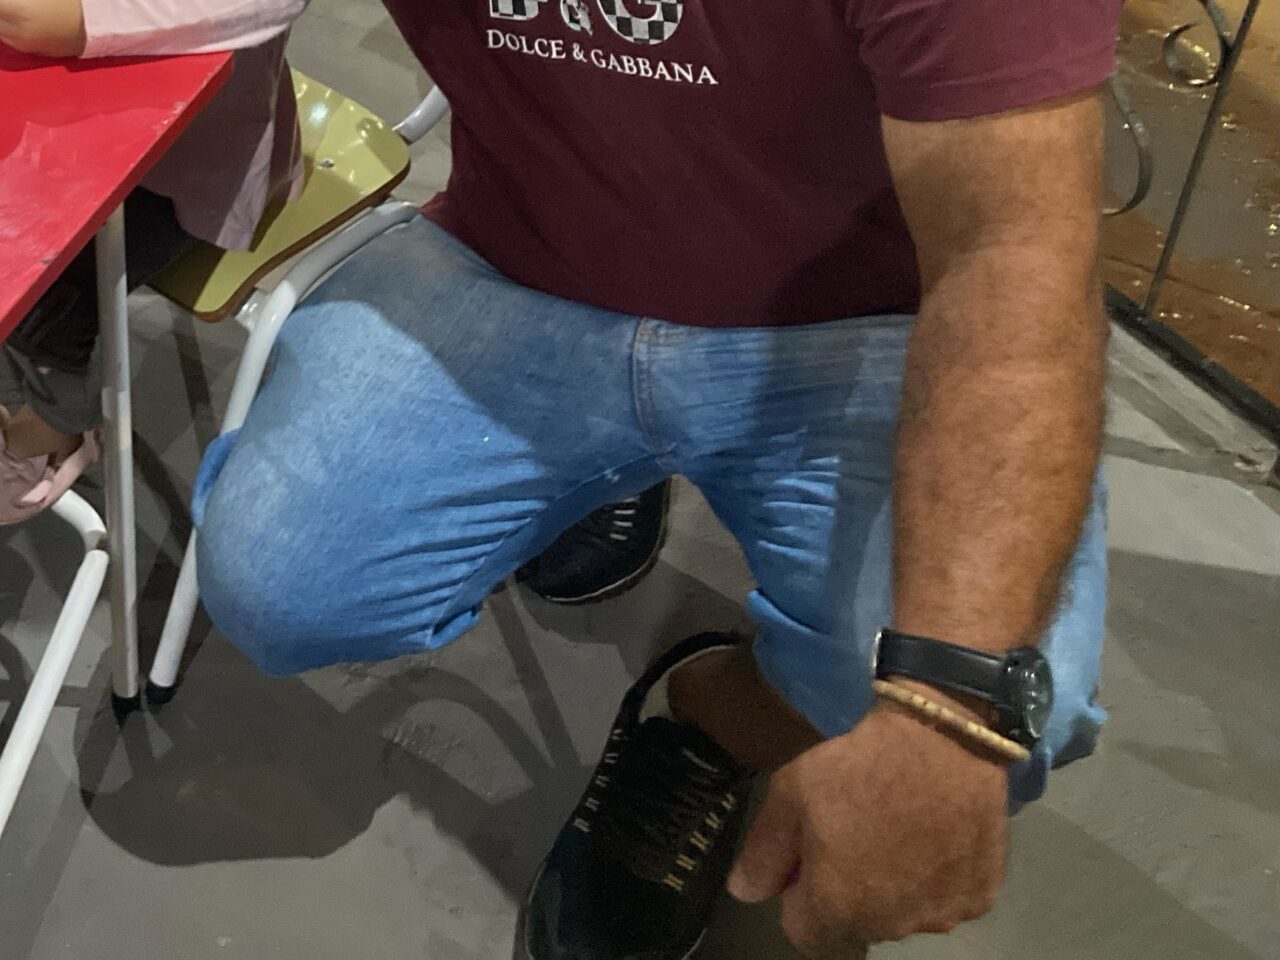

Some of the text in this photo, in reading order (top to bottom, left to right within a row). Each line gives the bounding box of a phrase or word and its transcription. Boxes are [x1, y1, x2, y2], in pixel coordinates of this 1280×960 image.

[486, 29, 718, 85] DOLCE & GABBANA
